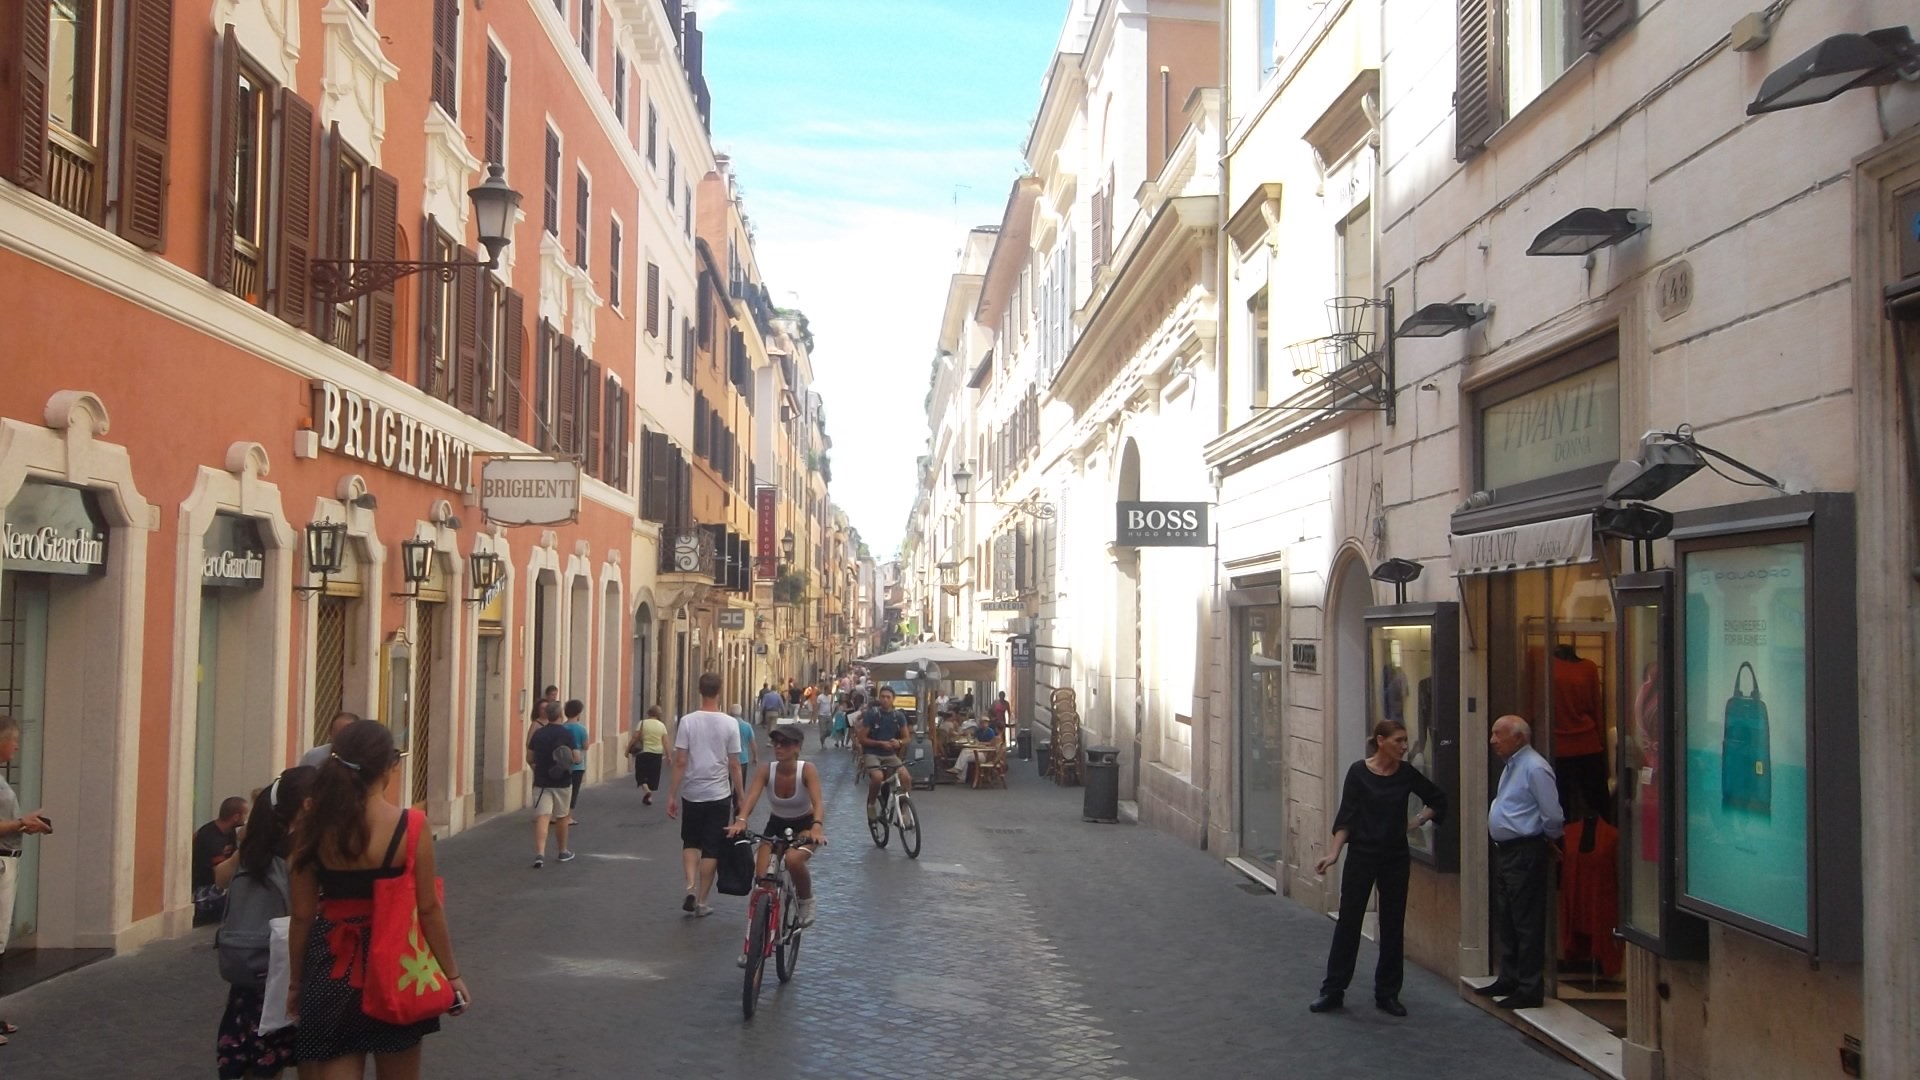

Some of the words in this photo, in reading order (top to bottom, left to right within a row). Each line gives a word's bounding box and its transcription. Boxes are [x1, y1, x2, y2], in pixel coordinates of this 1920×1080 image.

[1503, 378, 1597, 451] VIVANTI
[320, 380, 475, 494] BRIGHENTI
[1554, 435, 1592, 463] DONNA
[484, 478, 576, 498] BRIGHENTI
[1127, 509, 1198, 530] BOSS
[1470, 530, 1517, 564] VIVANTI
[1535, 539, 1561, 558] DONNA
[983, 602, 1025, 610] GELATERIA
